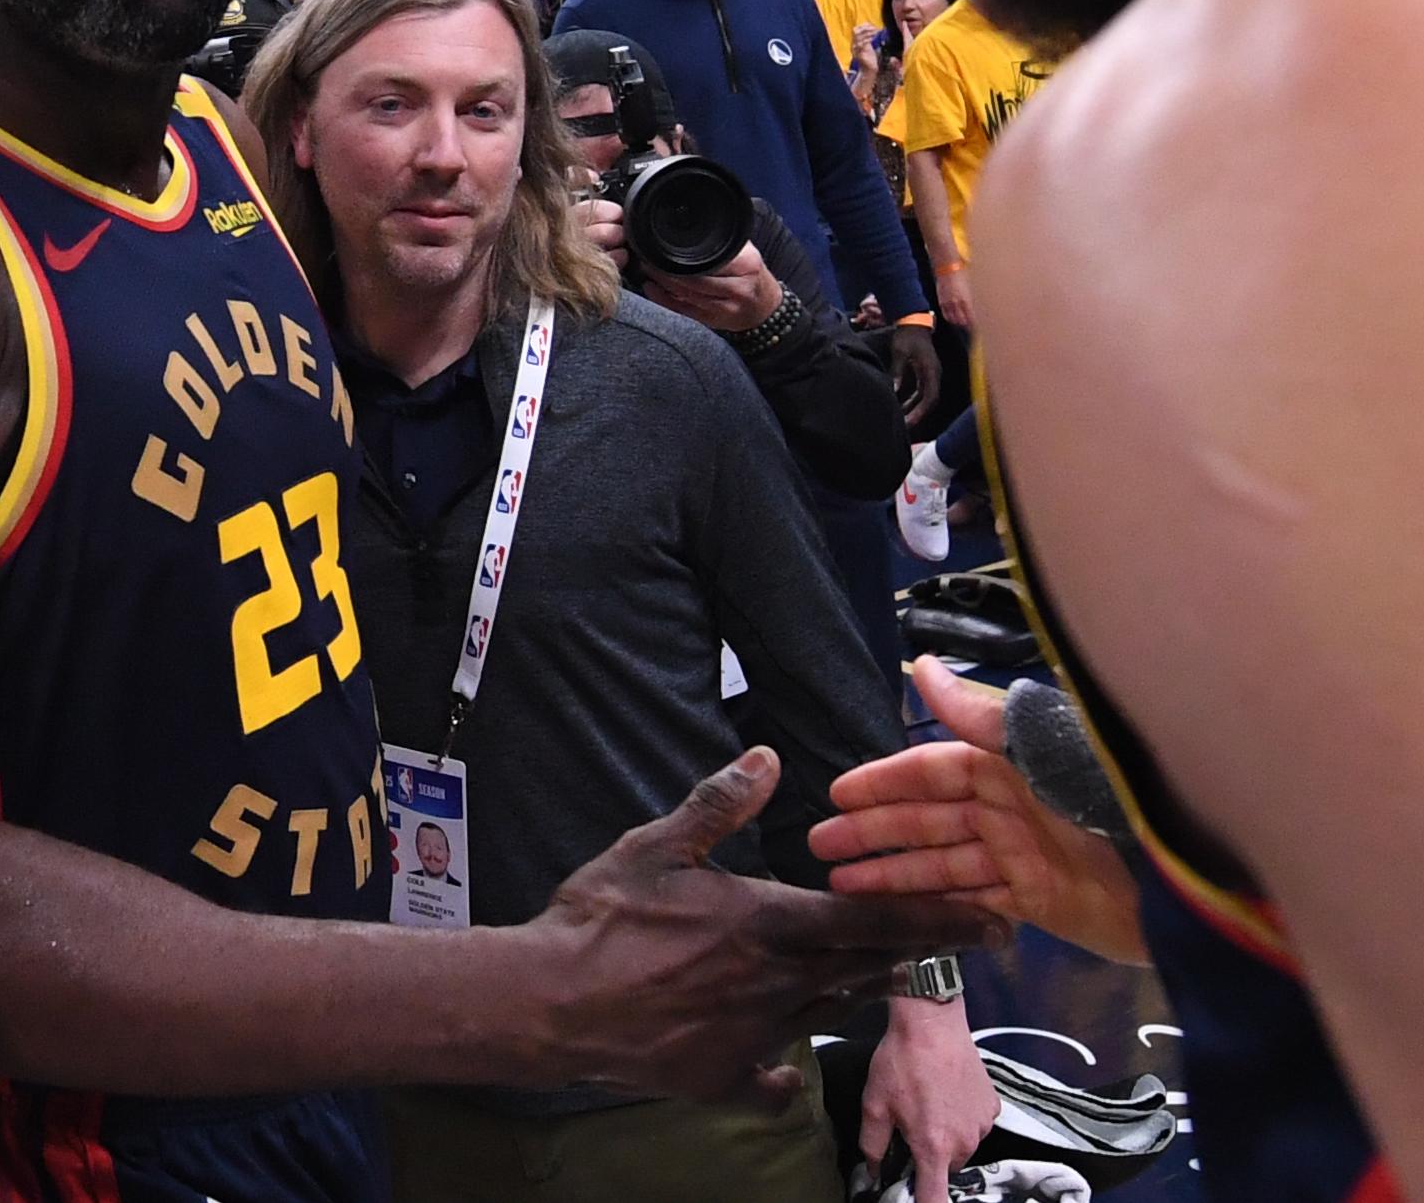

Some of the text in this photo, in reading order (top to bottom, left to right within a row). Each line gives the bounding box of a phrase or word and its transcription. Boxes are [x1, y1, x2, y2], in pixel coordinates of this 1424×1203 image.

[203, 199, 264, 234] Rakuten
[218, 472, 362, 735] 23
[191, 768, 388, 898] STA
